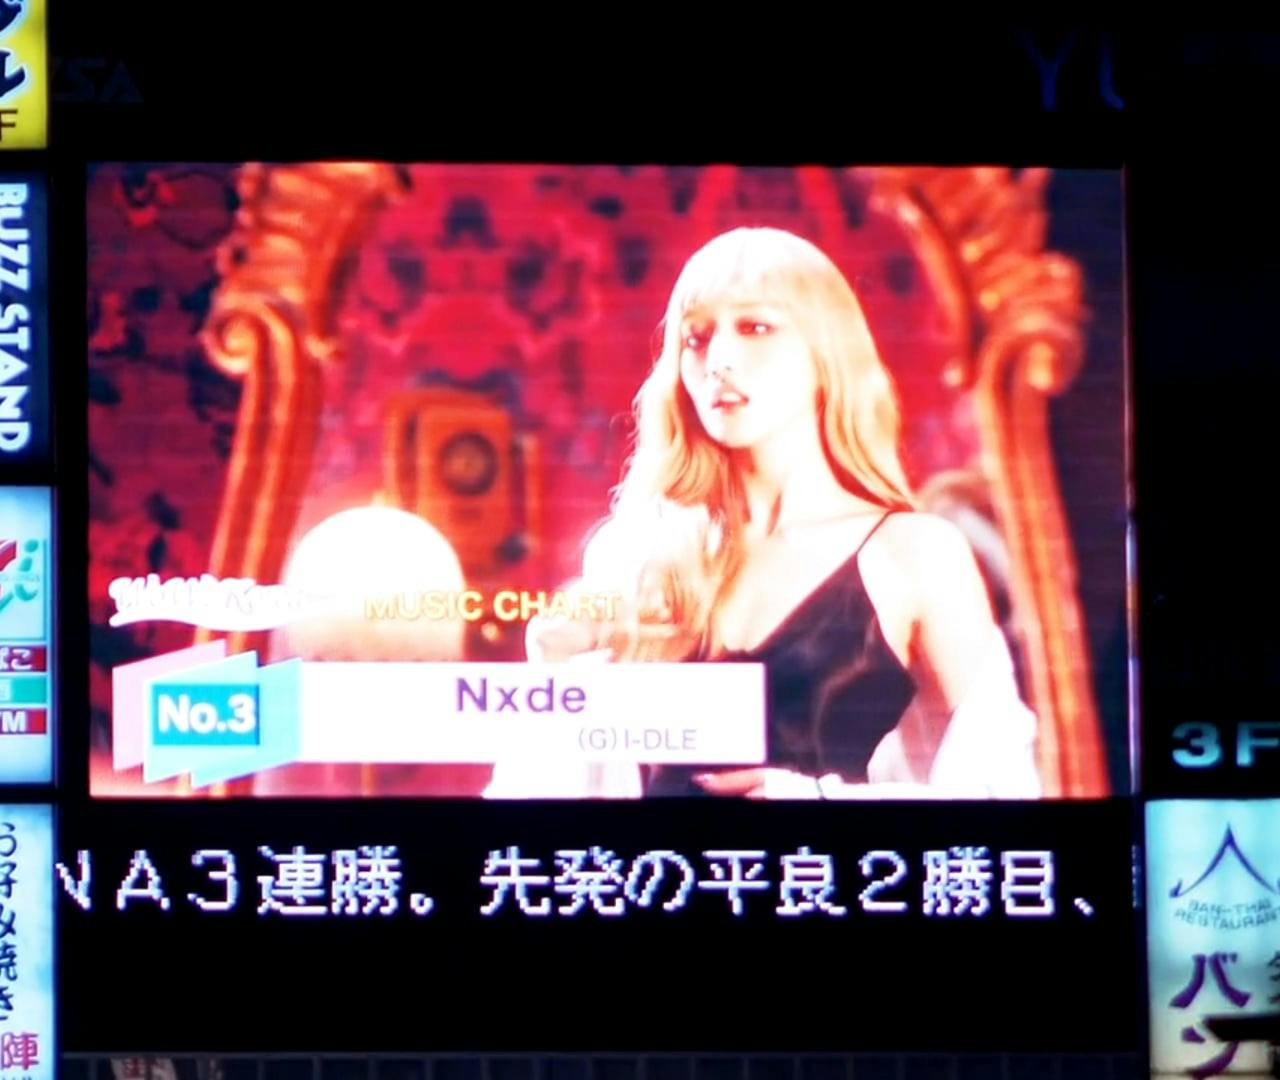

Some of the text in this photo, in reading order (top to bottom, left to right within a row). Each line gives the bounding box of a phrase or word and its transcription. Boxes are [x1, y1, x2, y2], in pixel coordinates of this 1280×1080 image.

[364, 591, 622, 622] MUSIC CHART
[457, 677, 588, 714] Nxde
[157, 693, 258, 737] No.3
